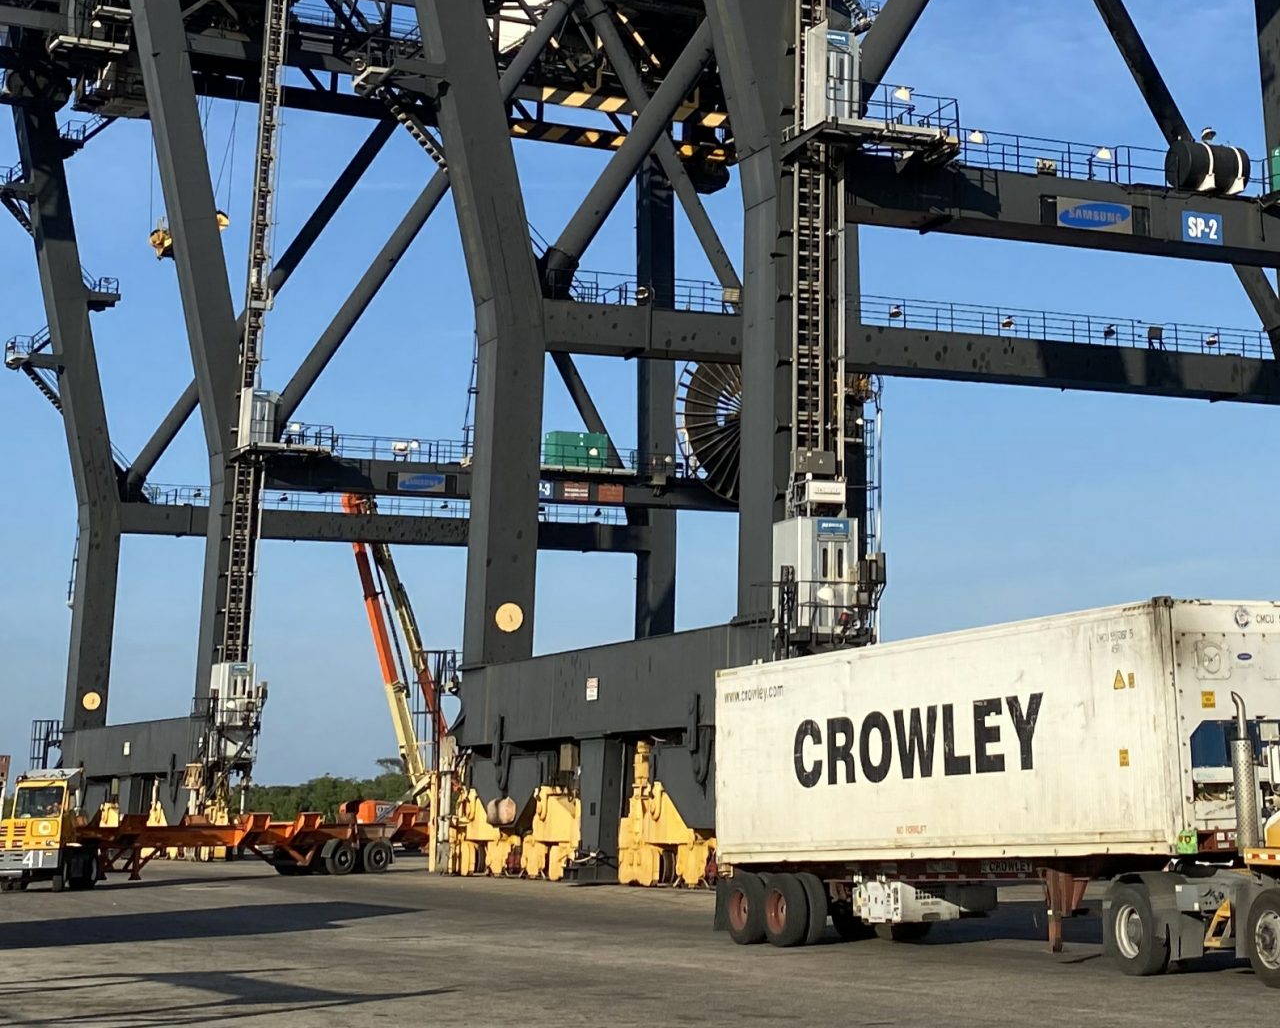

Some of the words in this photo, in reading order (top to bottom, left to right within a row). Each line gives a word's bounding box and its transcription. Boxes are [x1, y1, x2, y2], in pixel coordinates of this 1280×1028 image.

[1068, 208, 1122, 222] SAMSUNG
[1187, 216, 1218, 240] SP-2
[1256, 614, 1275, 623] CMCU
[724, 684, 784, 704] www.crowley.com
[794, 692, 1044, 788] CROWLEY
[22, 851, 44, 868] 41
[989, 860, 1032, 872] CROWLEY
